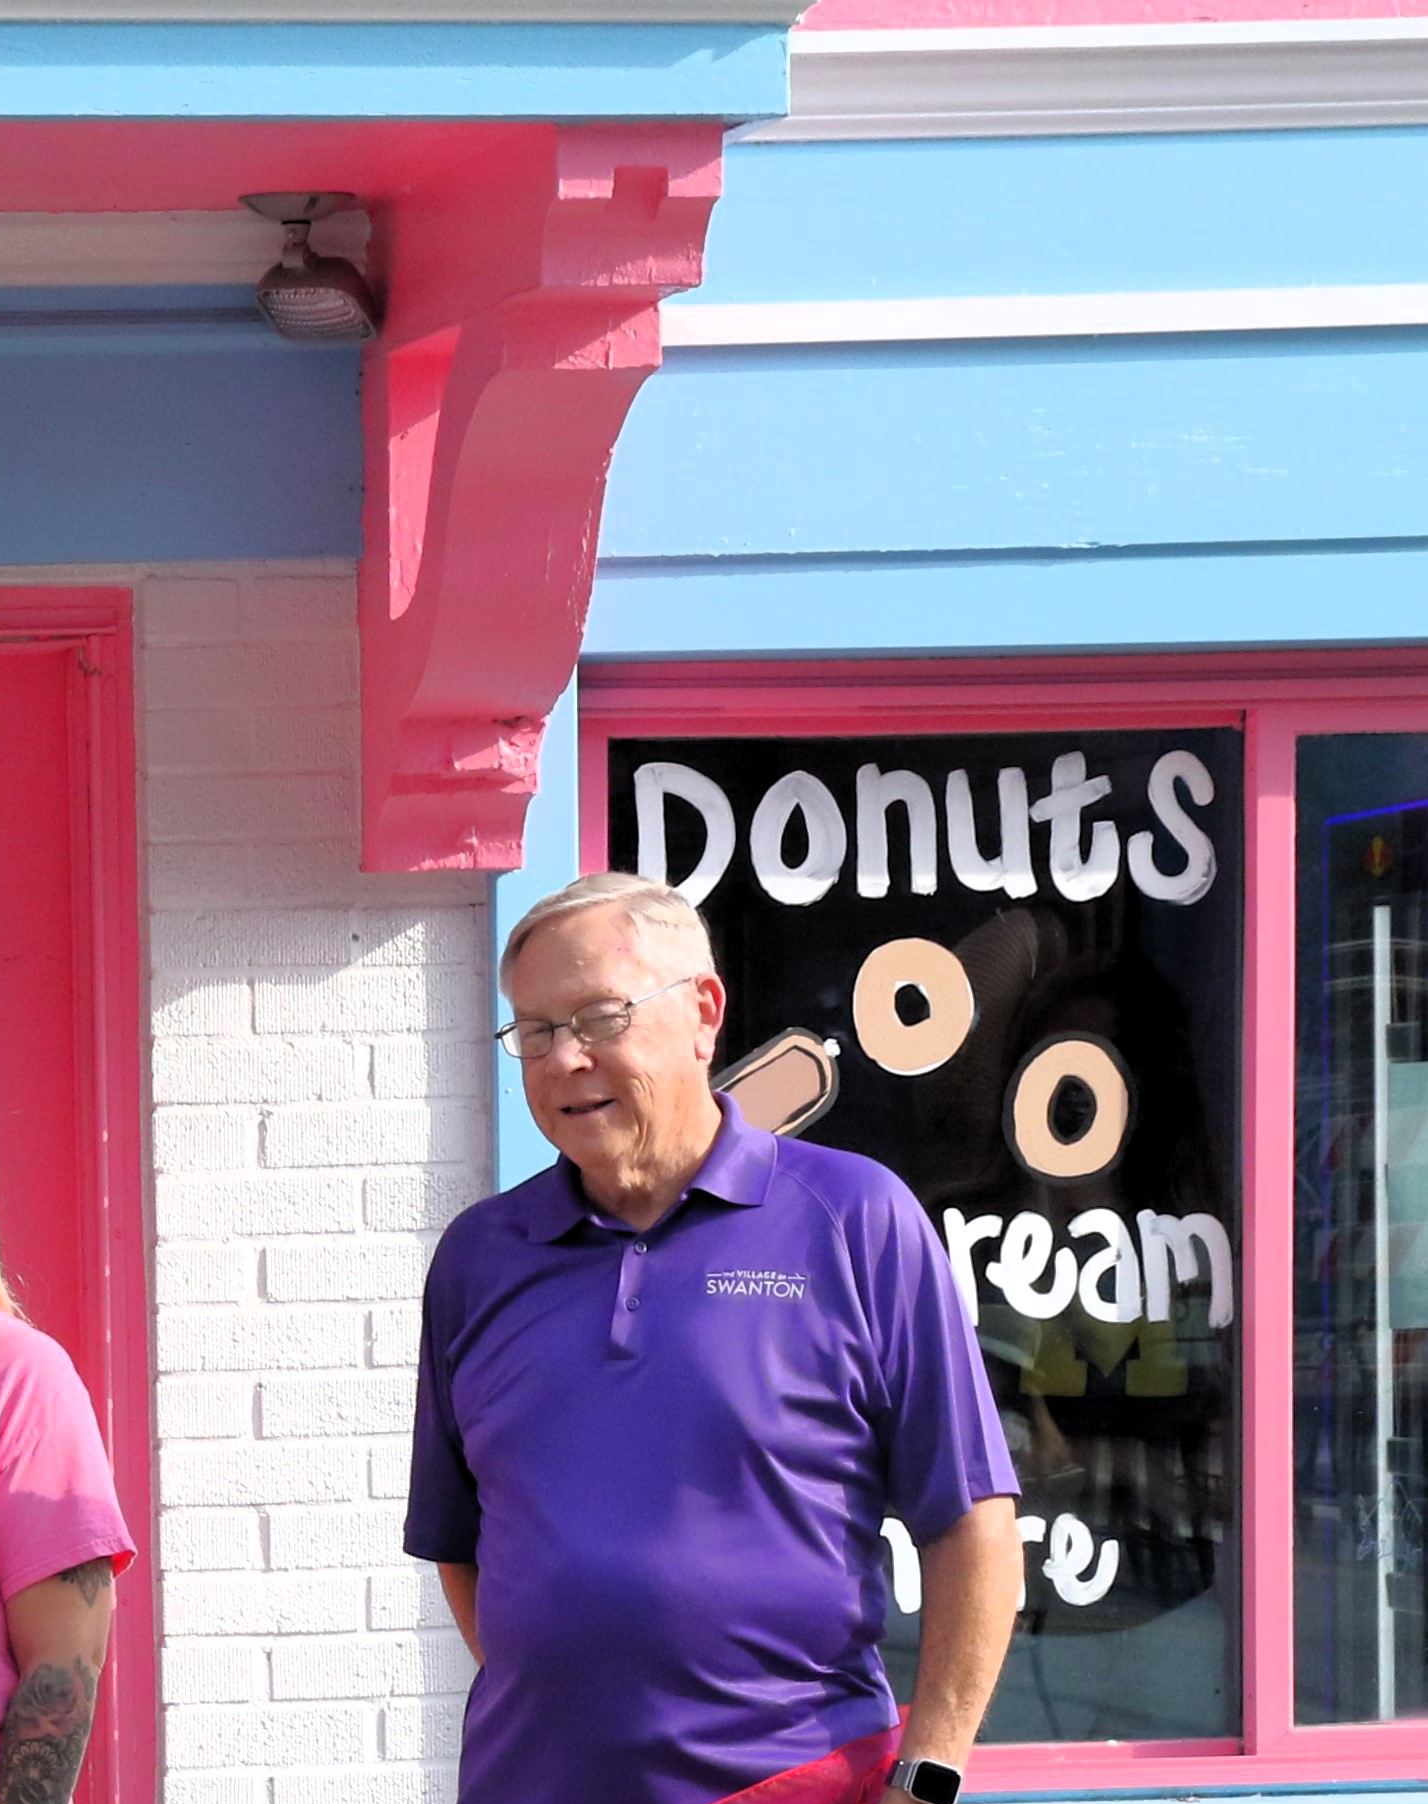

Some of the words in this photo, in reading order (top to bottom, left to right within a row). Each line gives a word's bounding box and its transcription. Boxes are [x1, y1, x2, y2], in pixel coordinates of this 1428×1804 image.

[736, 1269, 776, 1280] VILLAGE
[943, 1206, 1234, 1329] ream
[706, 1279, 805, 1299] SWANTON
